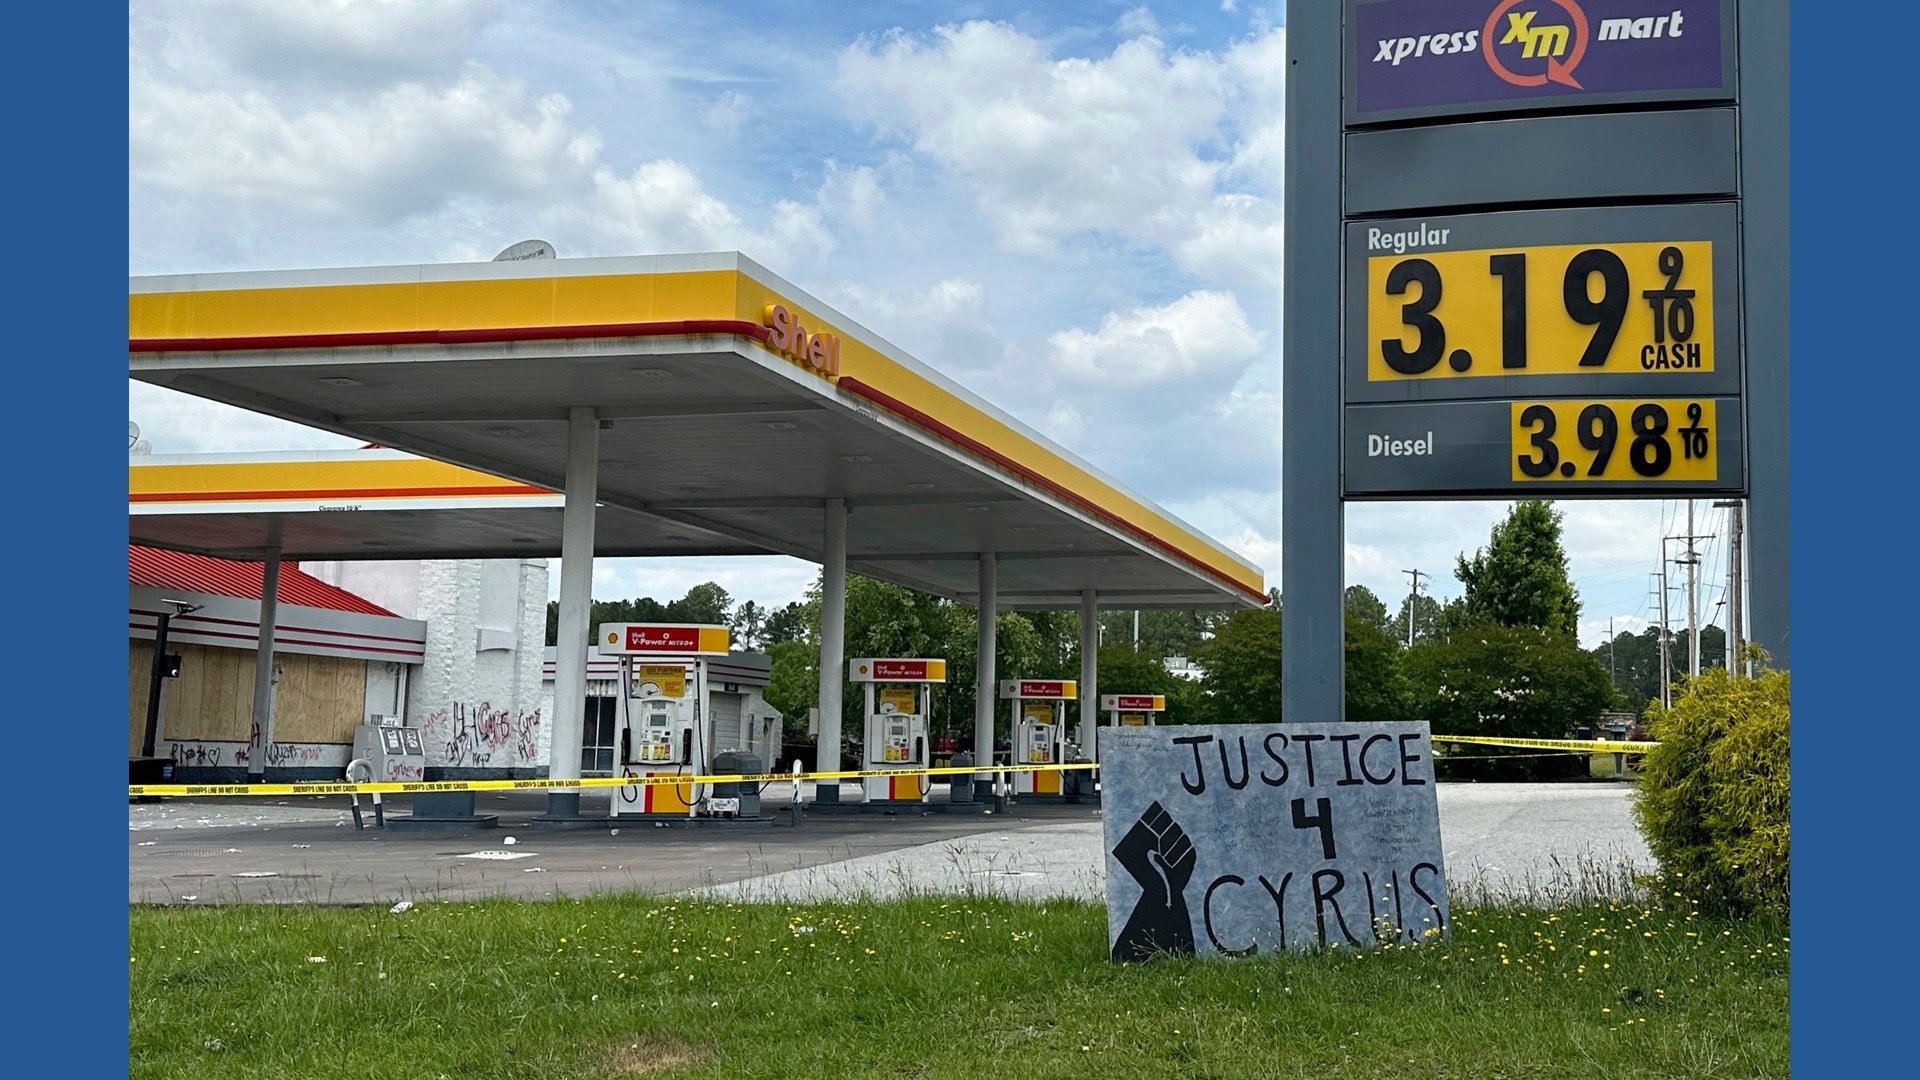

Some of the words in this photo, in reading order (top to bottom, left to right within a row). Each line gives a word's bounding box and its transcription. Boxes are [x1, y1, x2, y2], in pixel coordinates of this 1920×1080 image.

[1373, 29, 1480, 66] xpress
[1598, 9, 1684, 43] mart
[1368, 222, 1451, 254] Regular
[771, 304, 840, 376] Shell
[1381, 248, 1630, 375] 3.19
[1641, 343, 1701, 370] CASH
[1368, 431, 1434, 457] Diesel
[1518, 403, 1672, 477] 3.98
[631, 638, 667, 646] V-Power
[1173, 732, 1426, 795] JUSTICE
[1290, 798, 1337, 860] 4
[1204, 862, 1445, 957] CYRUS
